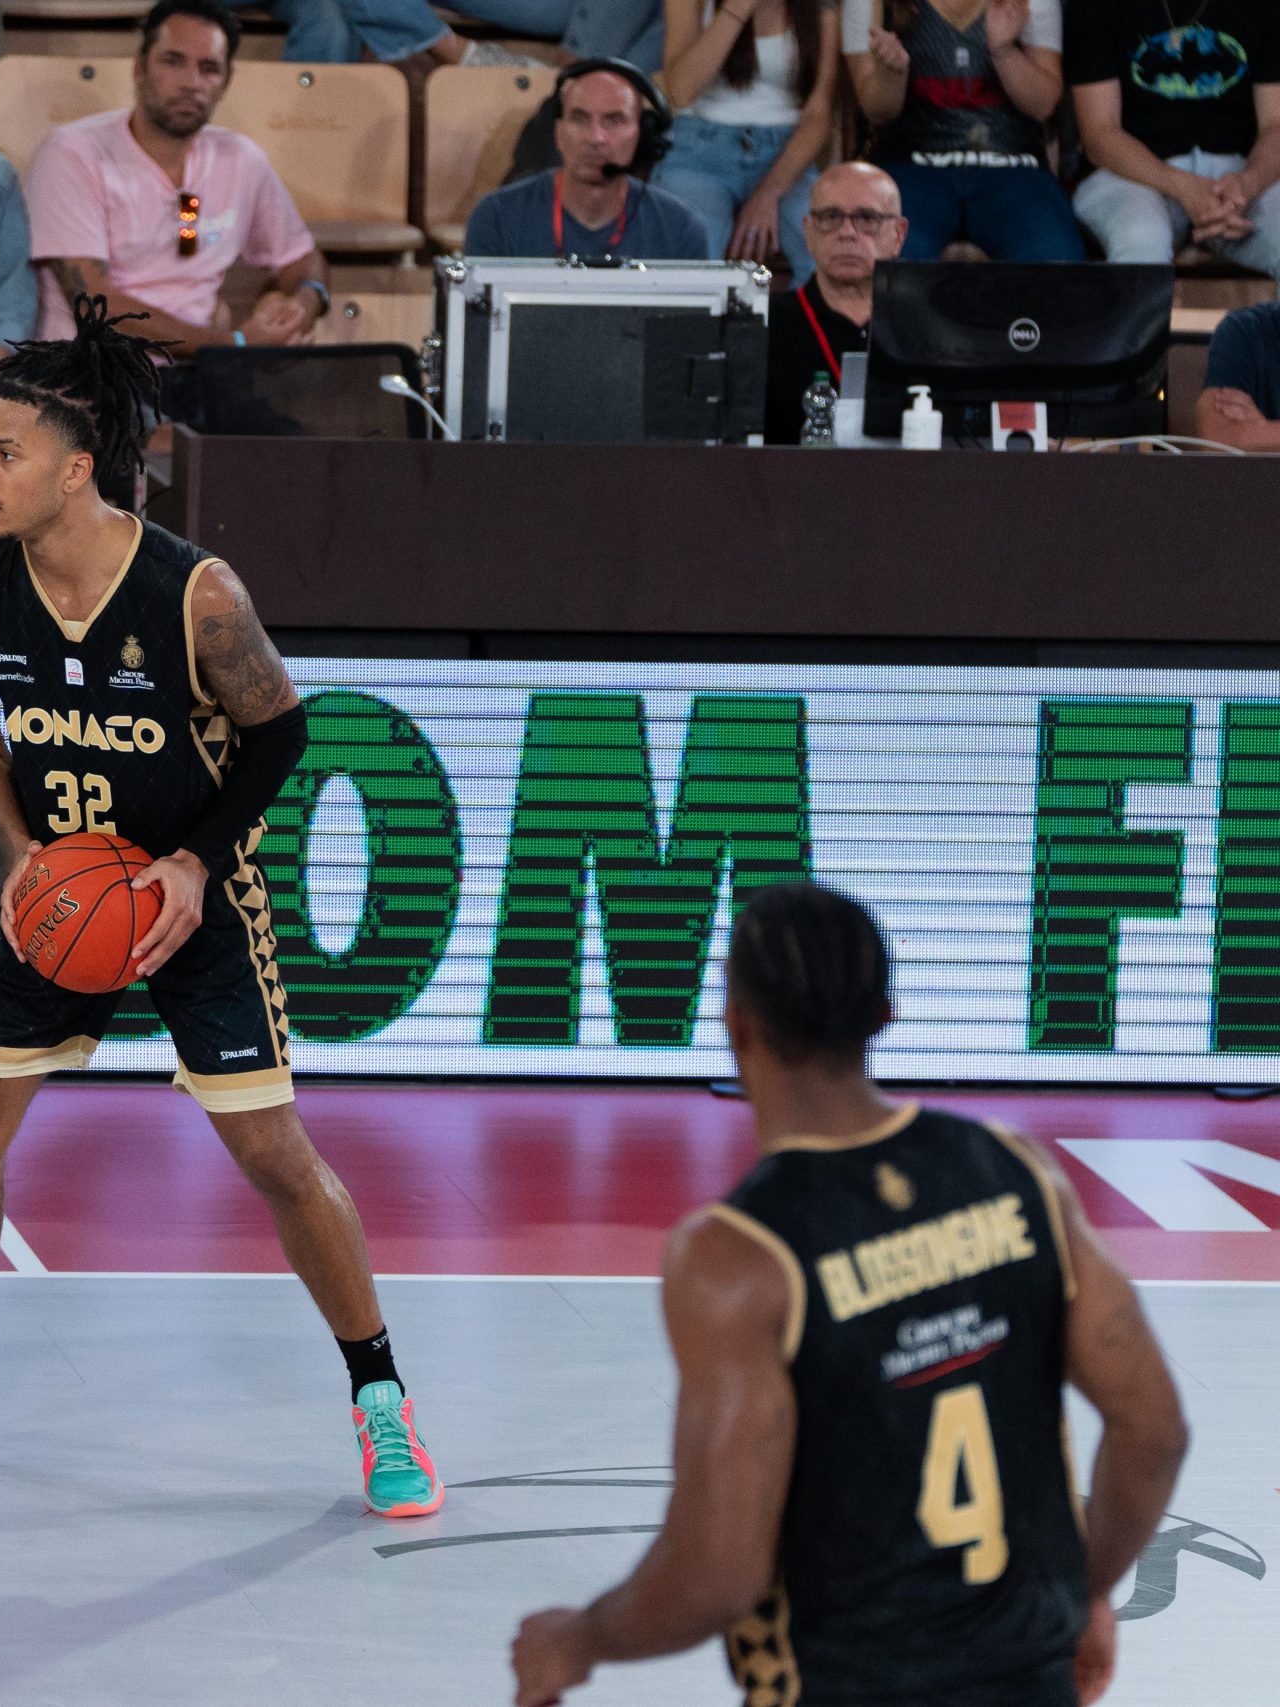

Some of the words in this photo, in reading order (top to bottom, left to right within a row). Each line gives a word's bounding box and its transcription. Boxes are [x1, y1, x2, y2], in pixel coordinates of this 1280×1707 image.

[5, 705, 166, 754] MONACO
[44, 770, 117, 836] 32
[220, 1046, 258, 1061] SPALDING
[914, 1382, 1010, 1585] 4
